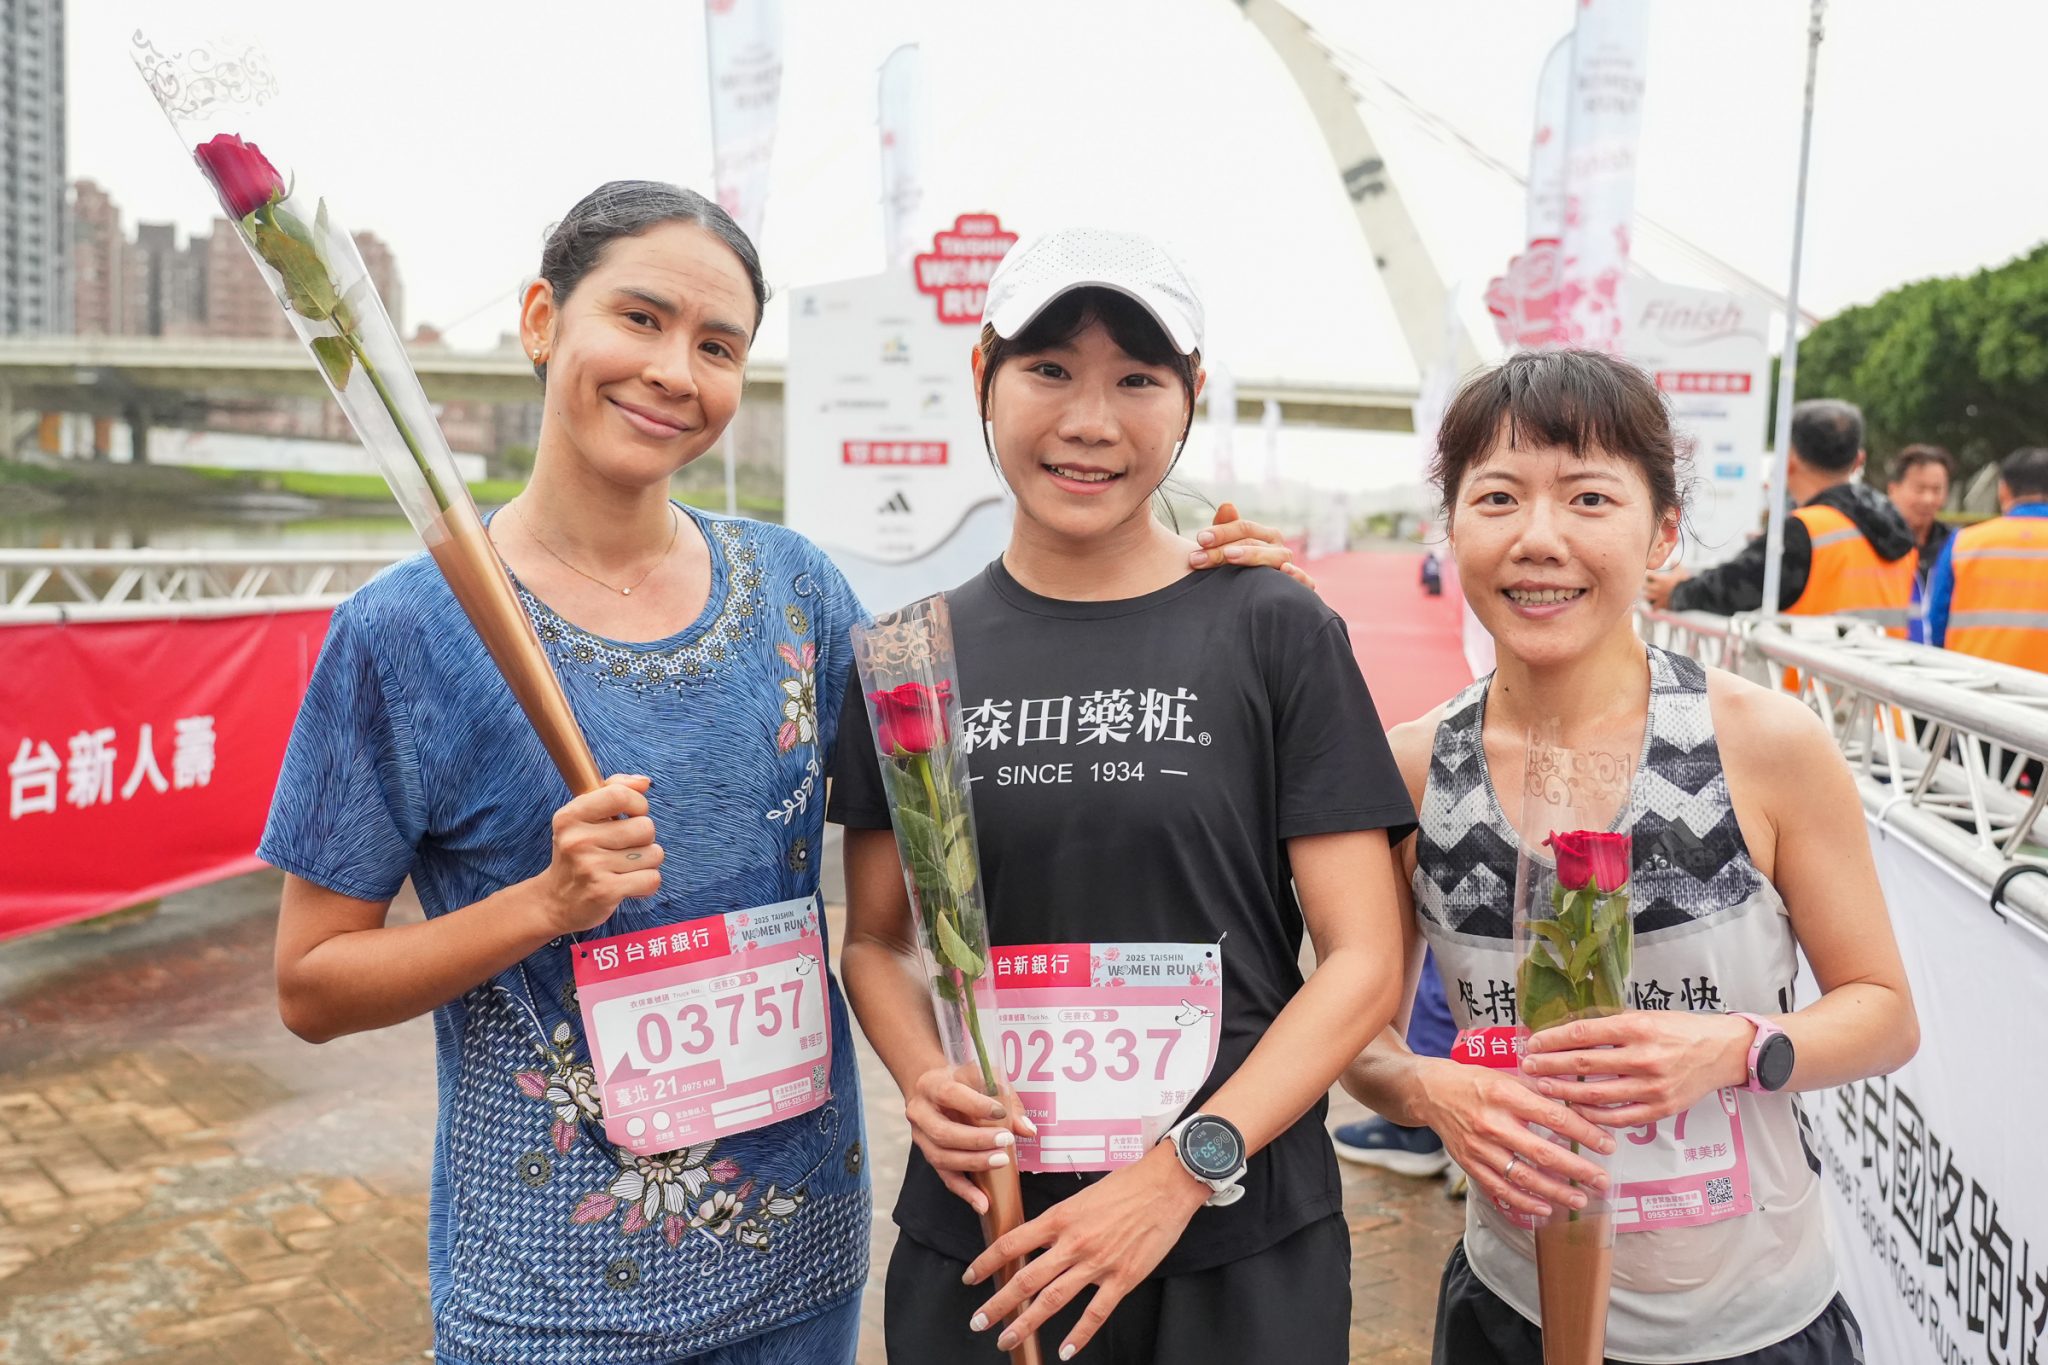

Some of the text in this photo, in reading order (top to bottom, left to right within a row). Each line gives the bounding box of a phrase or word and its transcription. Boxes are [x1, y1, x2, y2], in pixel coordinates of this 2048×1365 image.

[943, 288, 986, 316] RU
[1638, 300, 1743, 329] Finish
[8, 715, 216, 819] 台新人壽
[997, 761, 1145, 786] SINCE 1934
[742, 920, 805, 940] WOMEN RUN
[754, 911, 794, 925] 2025 TAISHIN
[625, 927, 710, 962] 台新銀行
[997, 953, 1070, 975] 台新銀行
[1107, 965, 1195, 977] WOMEN RUN
[1125, 954, 1183, 962] 2025 TAISHIN
[637, 979, 805, 1064] 03757
[1001, 1028, 1182, 1082] 02337
[615, 1084, 648, 1108] 臺北
[704, 1078, 717, 1088] KM
[1038, 1109, 1049, 1118] KM
[1684, 1142, 1728, 1162] 陳美彤
[1647, 1207, 1701, 1219] 0955-525-937
[1820, 1076, 2048, 1365] 華民國路跑
[1855, 1174, 1887, 1263] Taipei
[1890, 1235, 1925, 1328] Road
